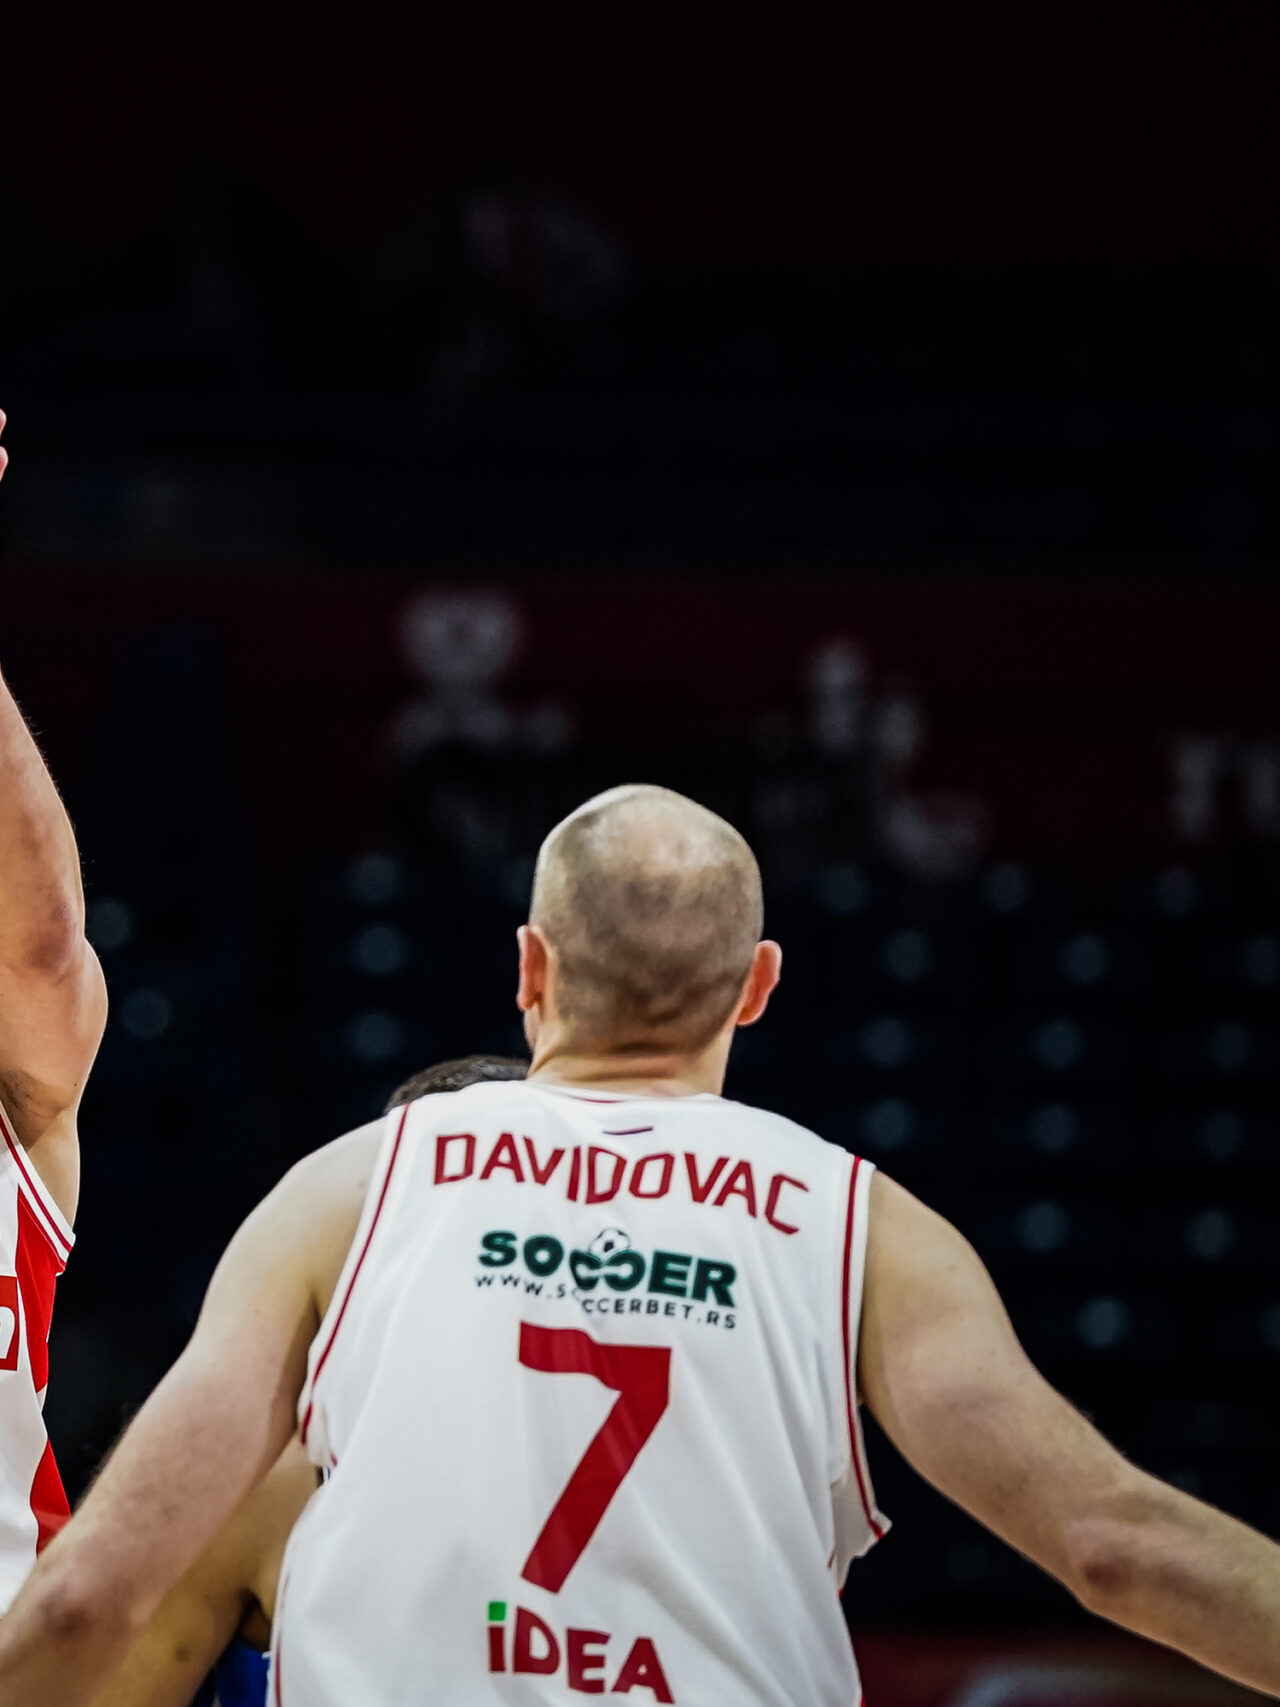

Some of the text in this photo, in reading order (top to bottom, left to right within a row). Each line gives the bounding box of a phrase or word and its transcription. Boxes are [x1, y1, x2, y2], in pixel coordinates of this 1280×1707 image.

[433, 1132, 810, 1235] DAVIDOVAC
[477, 1230, 738, 1308] SOCCER
[518, 1320, 672, 1595] 7
